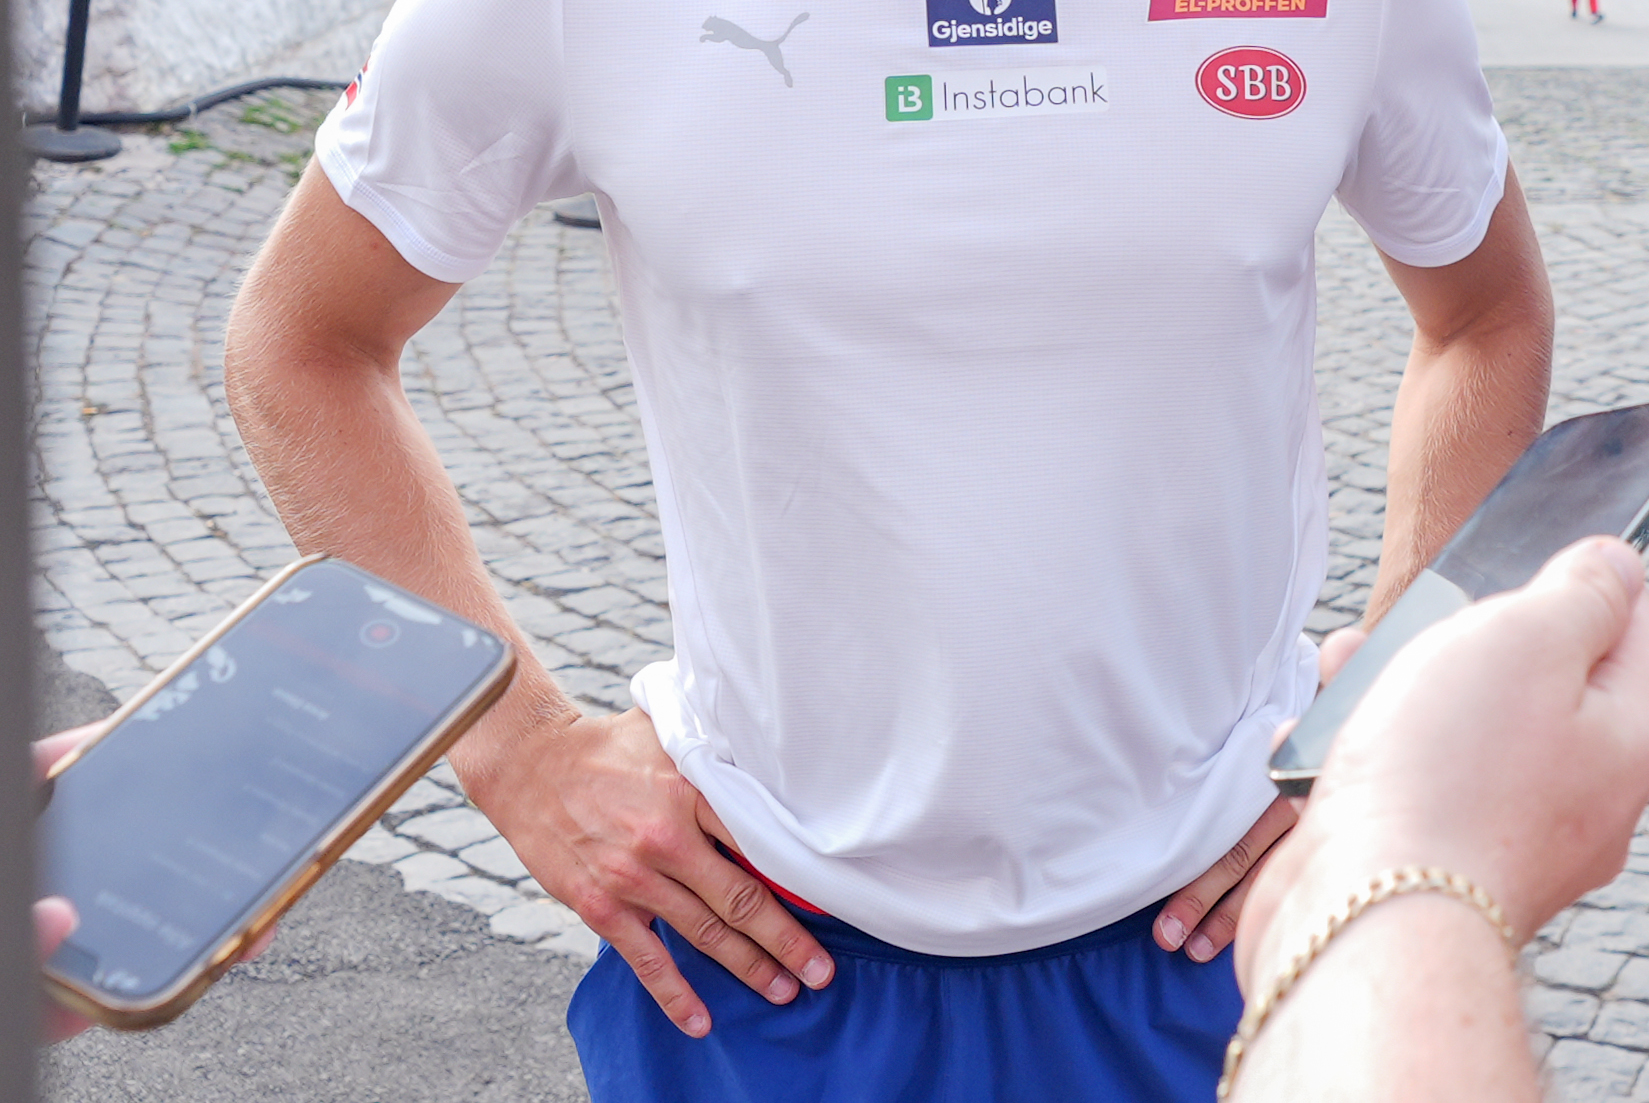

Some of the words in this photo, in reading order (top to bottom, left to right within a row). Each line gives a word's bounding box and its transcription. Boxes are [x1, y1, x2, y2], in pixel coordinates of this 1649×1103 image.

[931, 17, 1053, 43] Gjensidige
[943, 72, 1108, 111] Instabank
[1215, 64, 1293, 102] SBB
